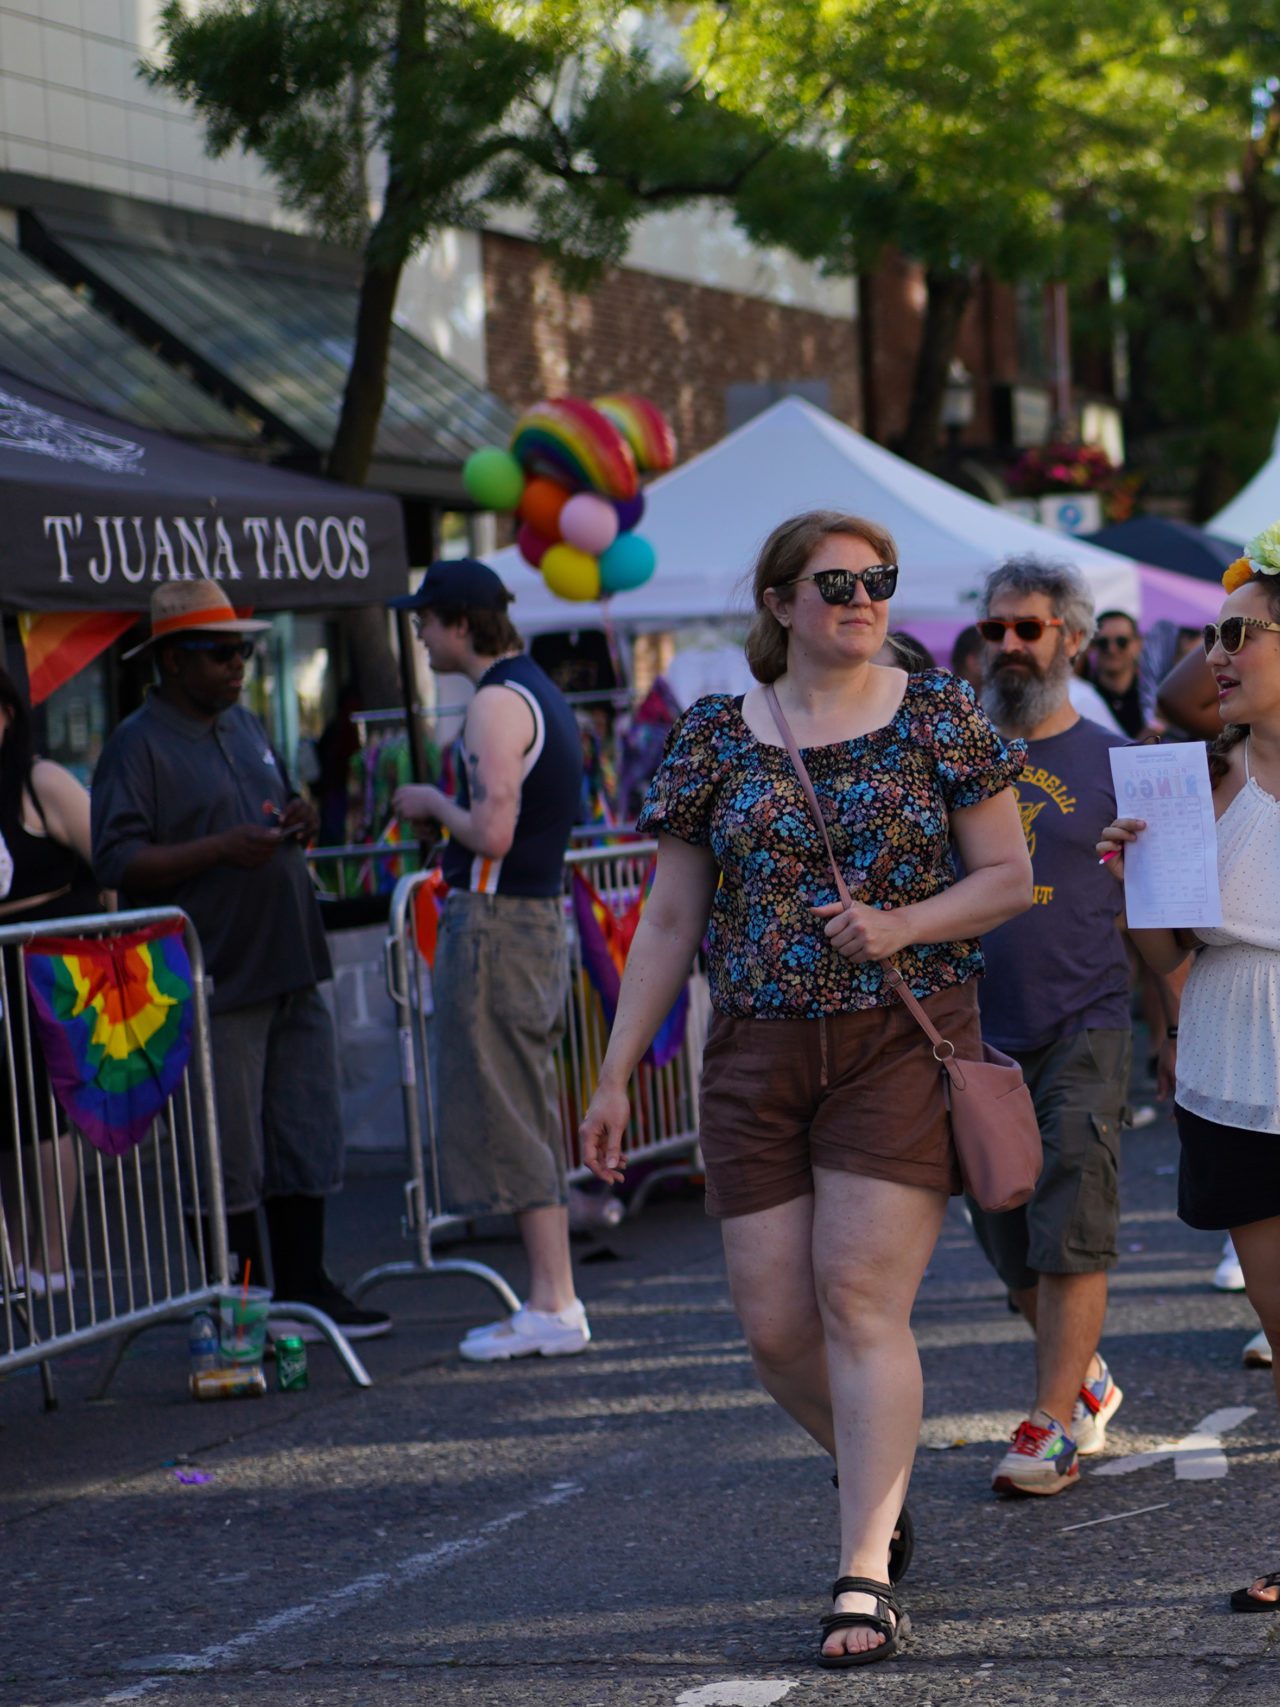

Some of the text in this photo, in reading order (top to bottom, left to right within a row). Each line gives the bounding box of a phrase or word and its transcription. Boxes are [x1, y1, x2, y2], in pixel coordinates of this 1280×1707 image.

[243, 515, 371, 580] TACOS
[1018, 764, 1077, 815] SBELL
[1032, 885, 1055, 906] IT
